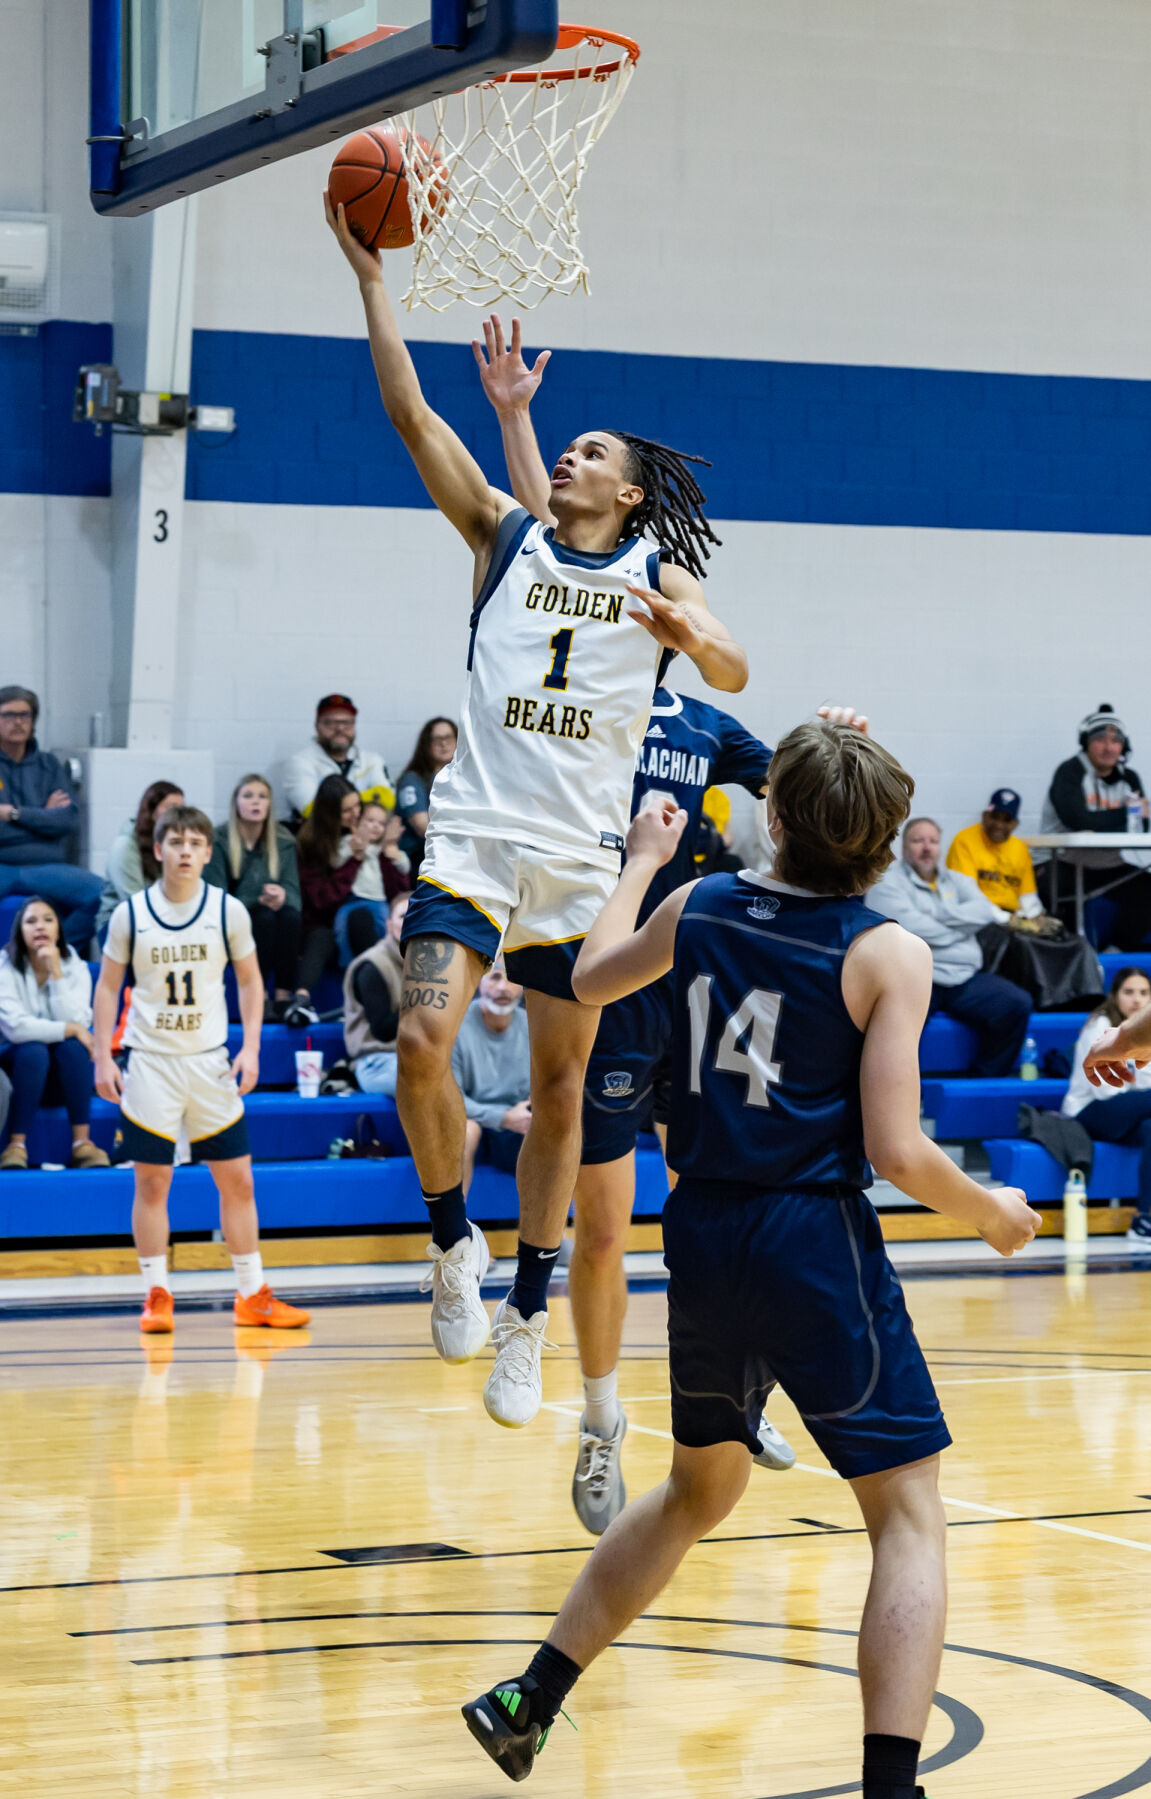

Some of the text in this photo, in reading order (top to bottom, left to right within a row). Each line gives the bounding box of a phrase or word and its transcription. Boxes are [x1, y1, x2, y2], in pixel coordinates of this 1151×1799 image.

[153, 508, 169, 544] 3
[525, 582, 624, 625] GOLDEN
[541, 626, 576, 693] 1
[503, 696, 594, 742] BEARS
[150, 943, 208, 965] GOLDEN
[164, 969, 197, 1007] 11
[155, 1012, 203, 1032] BEARS
[687, 971, 786, 1110] 14
